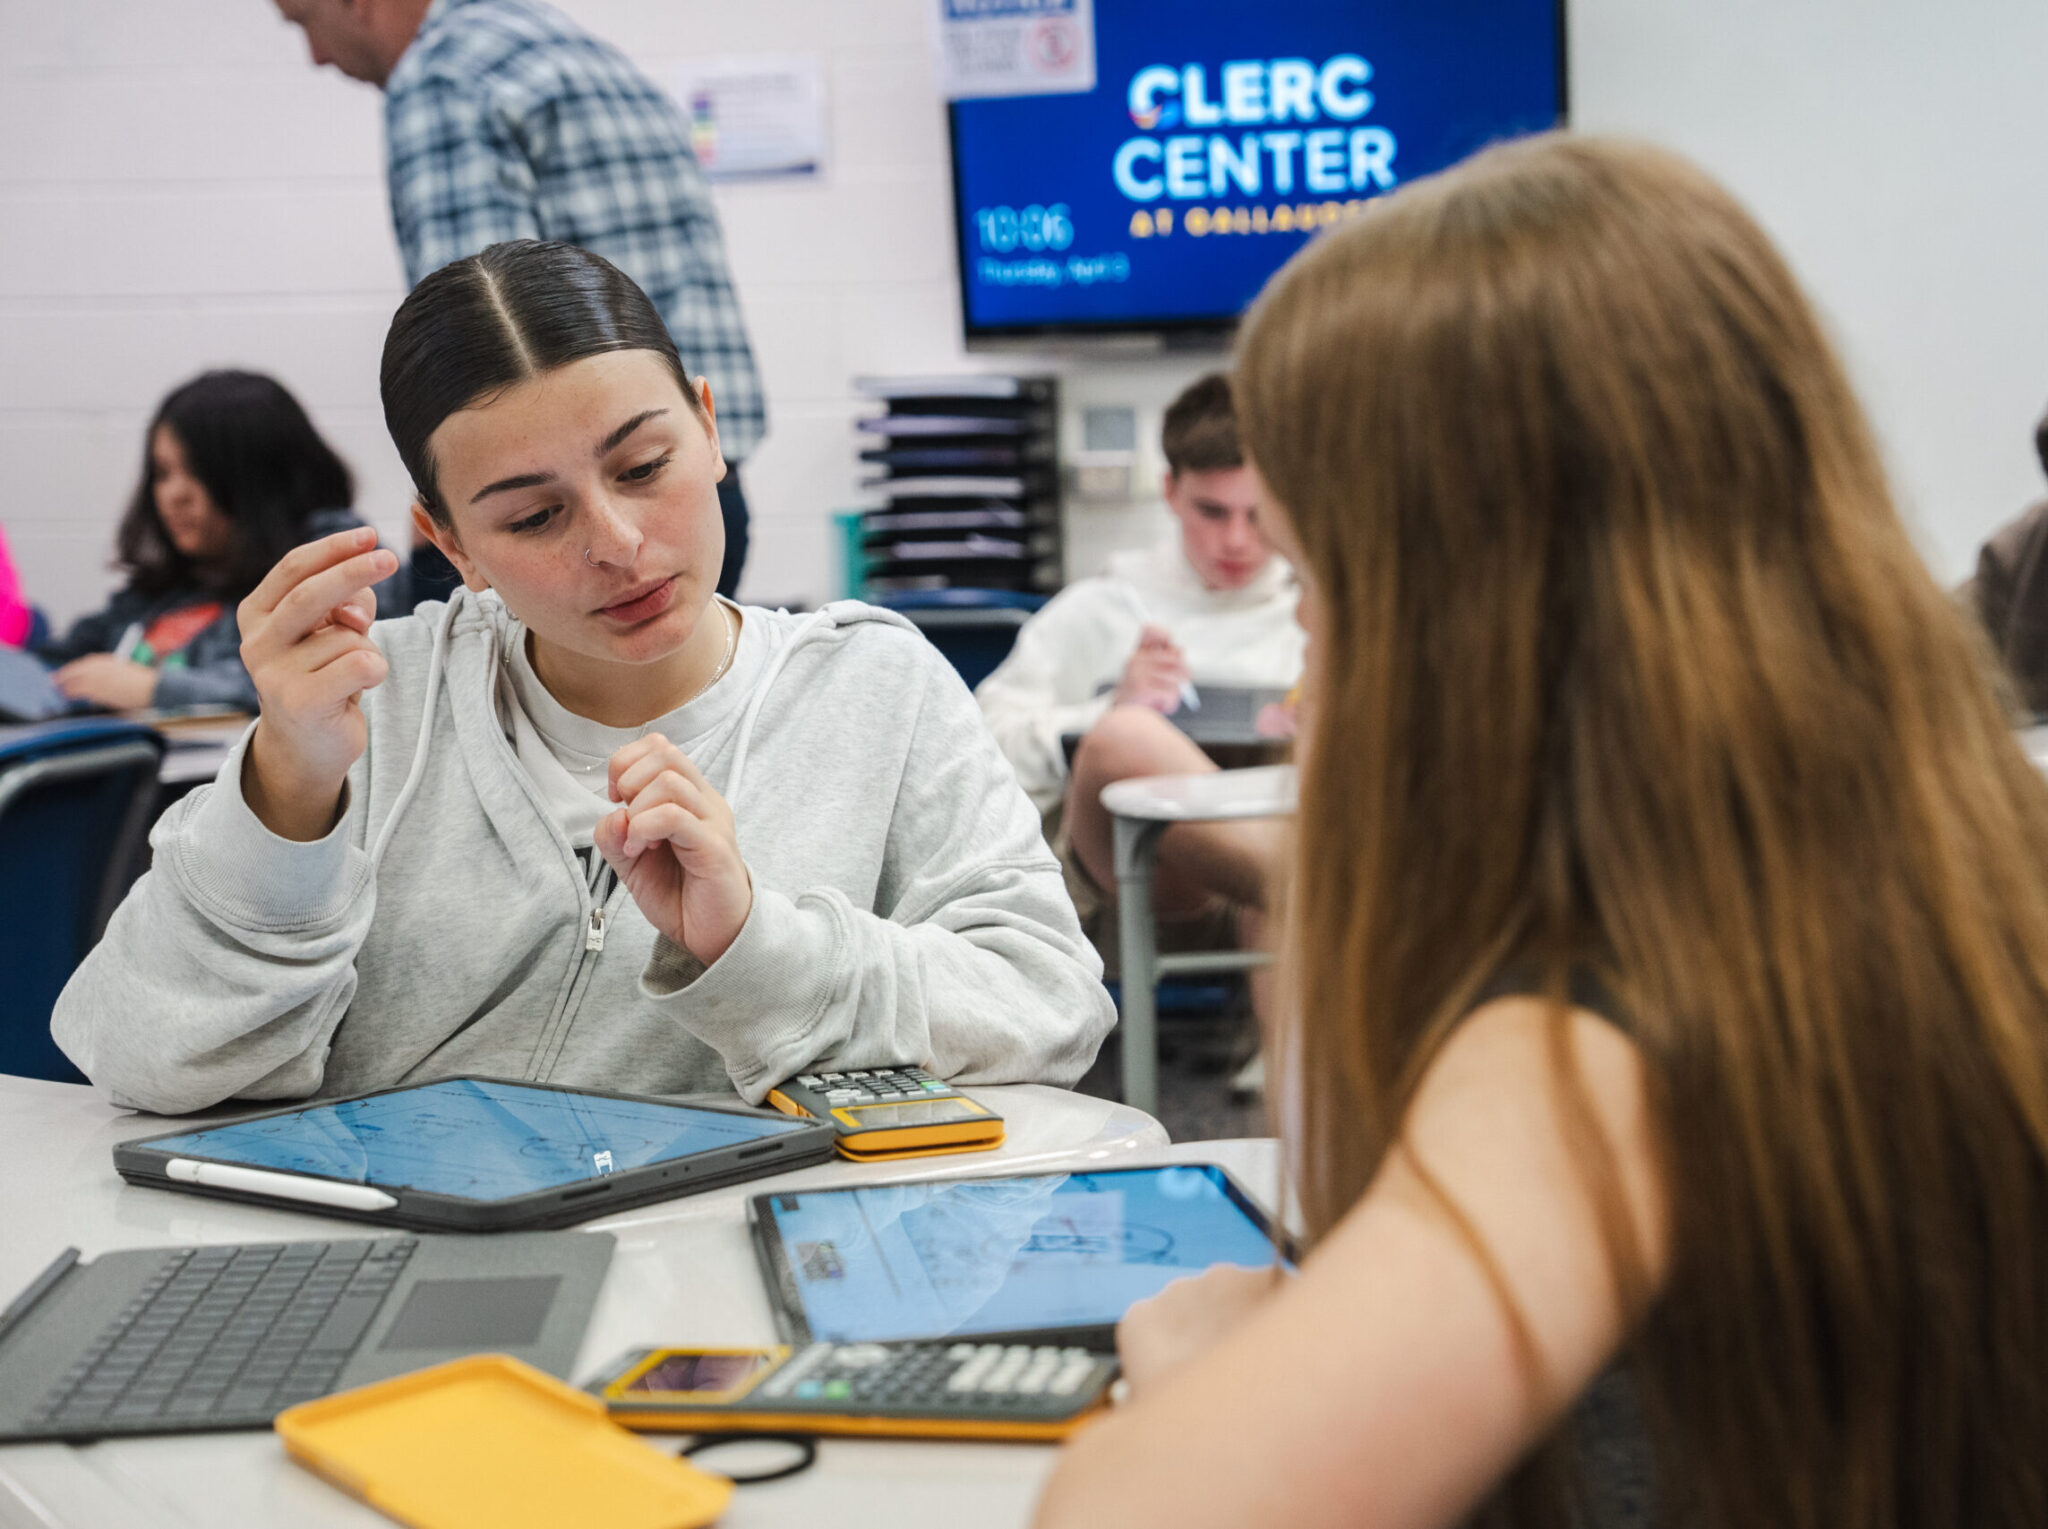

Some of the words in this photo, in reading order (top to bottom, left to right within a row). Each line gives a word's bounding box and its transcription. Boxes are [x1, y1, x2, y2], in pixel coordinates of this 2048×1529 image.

[1128, 53, 1375, 130] CLERC
[1112, 126, 1398, 202] CENTER
[1129, 208, 1174, 238] AT
